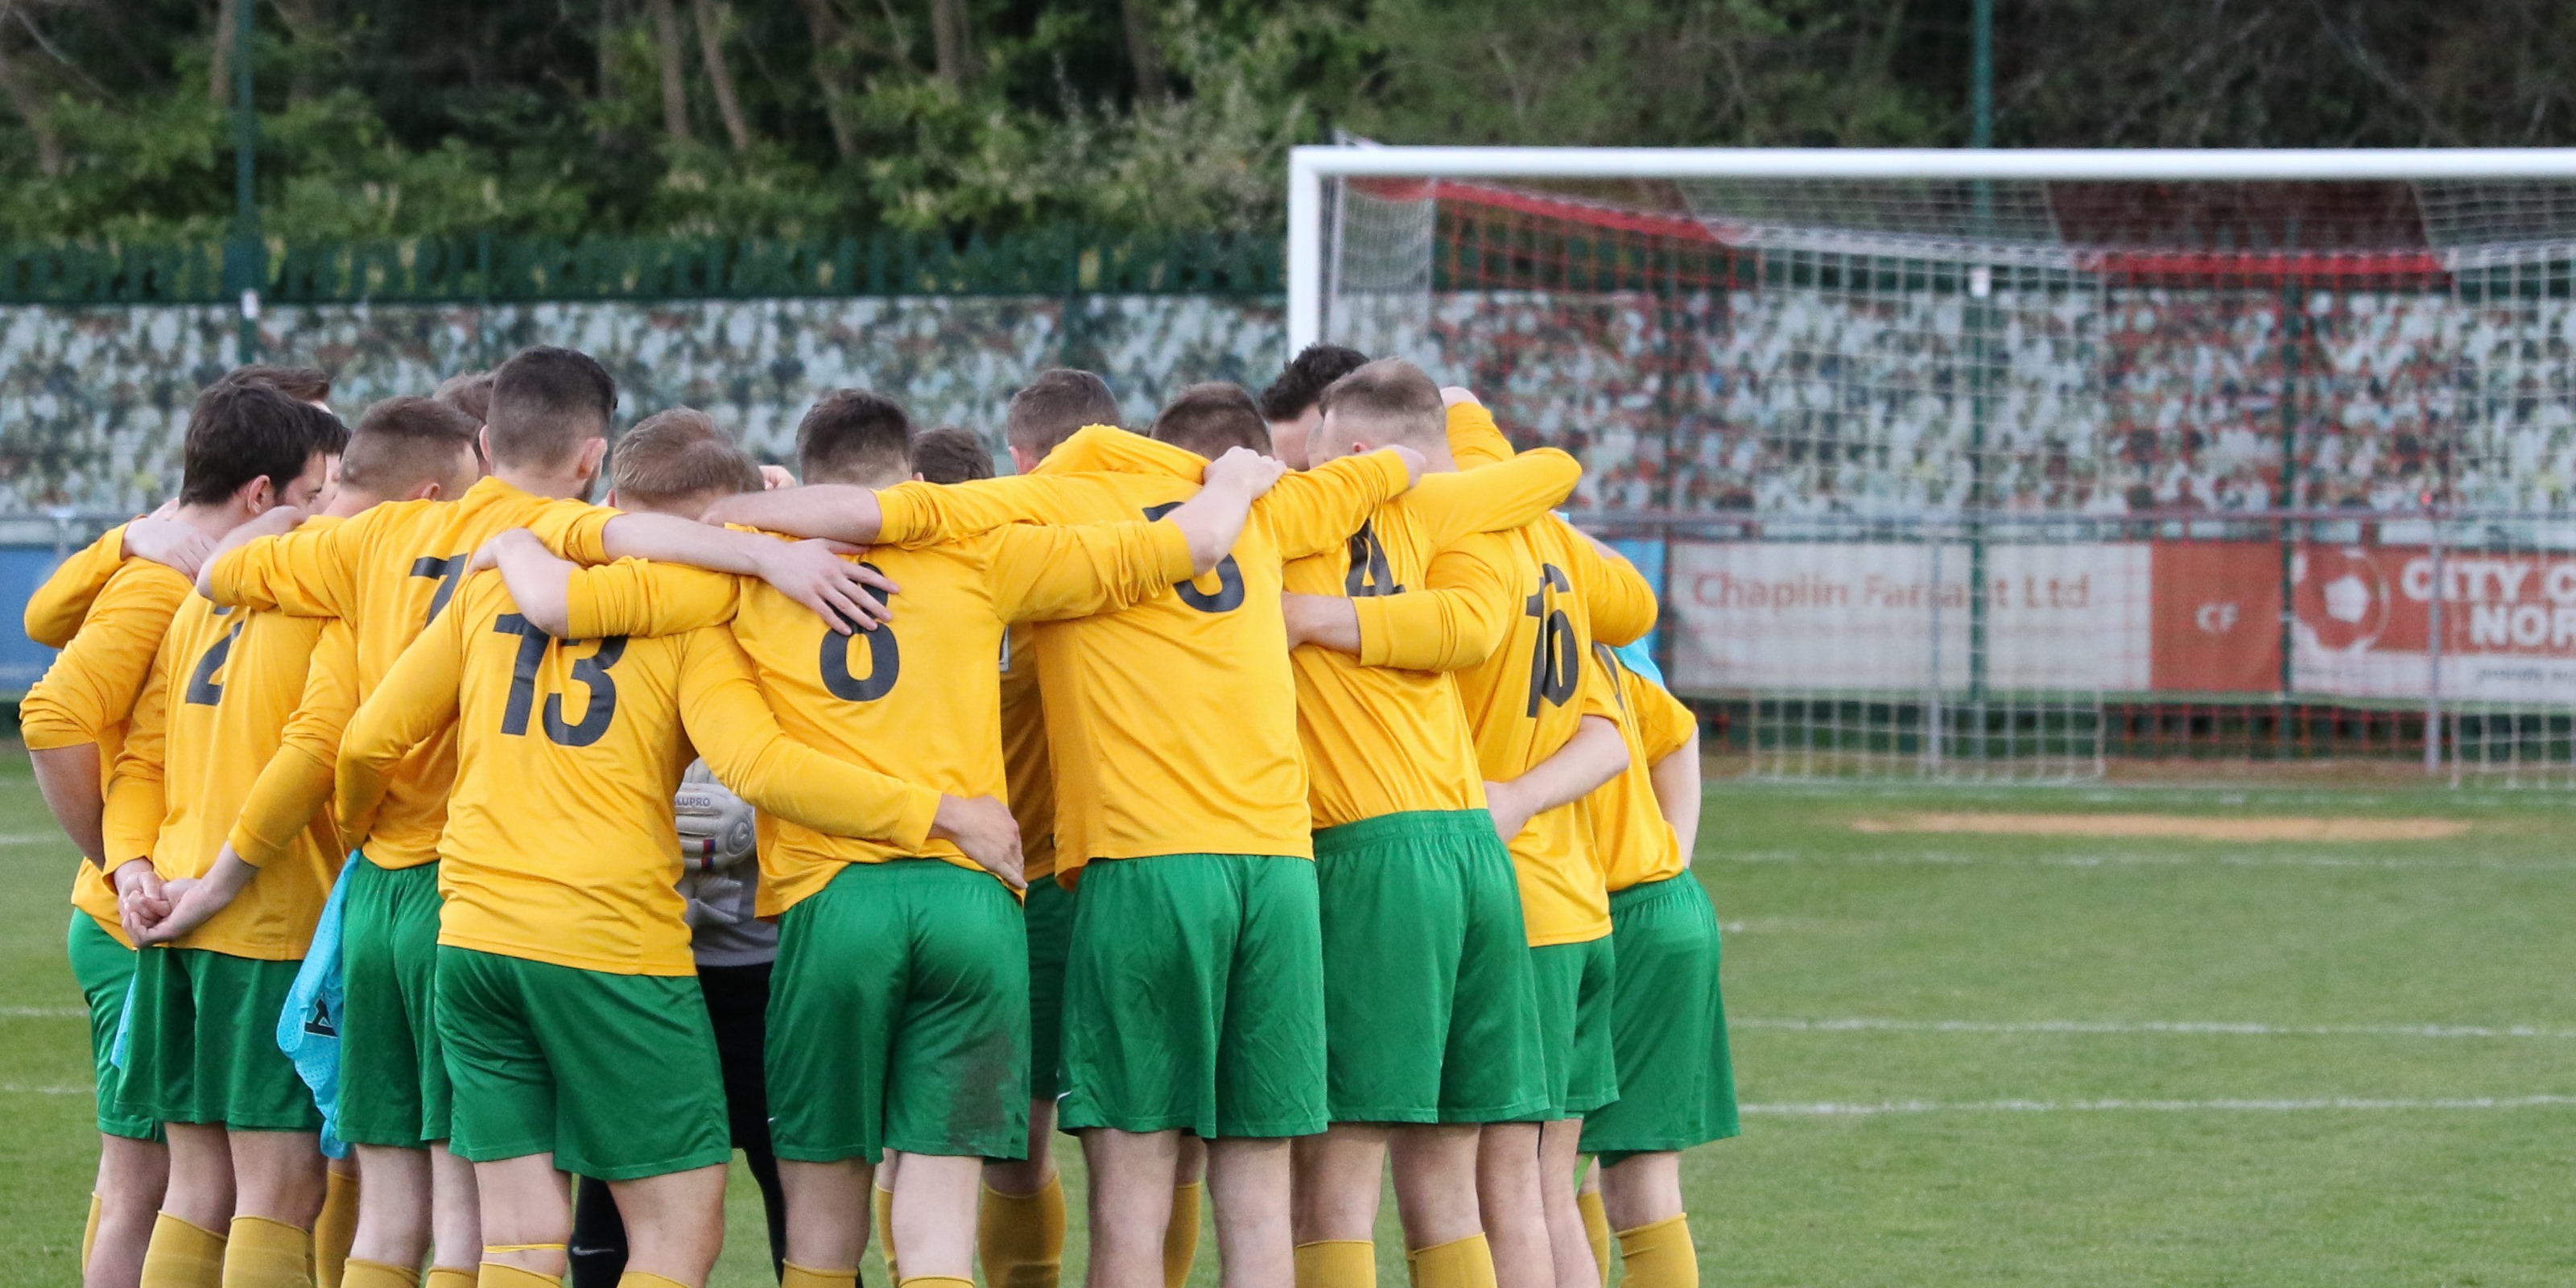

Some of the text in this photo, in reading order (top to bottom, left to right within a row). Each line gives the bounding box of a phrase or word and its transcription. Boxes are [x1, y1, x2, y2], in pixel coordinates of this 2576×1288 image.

[1692, 570, 1849, 615] Chaplin
[2025, 573, 2090, 609] Ltd
[2401, 557, 2530, 603] CITY
[493, 613, 629, 746] 13
[1526, 563, 1579, 718] 16
